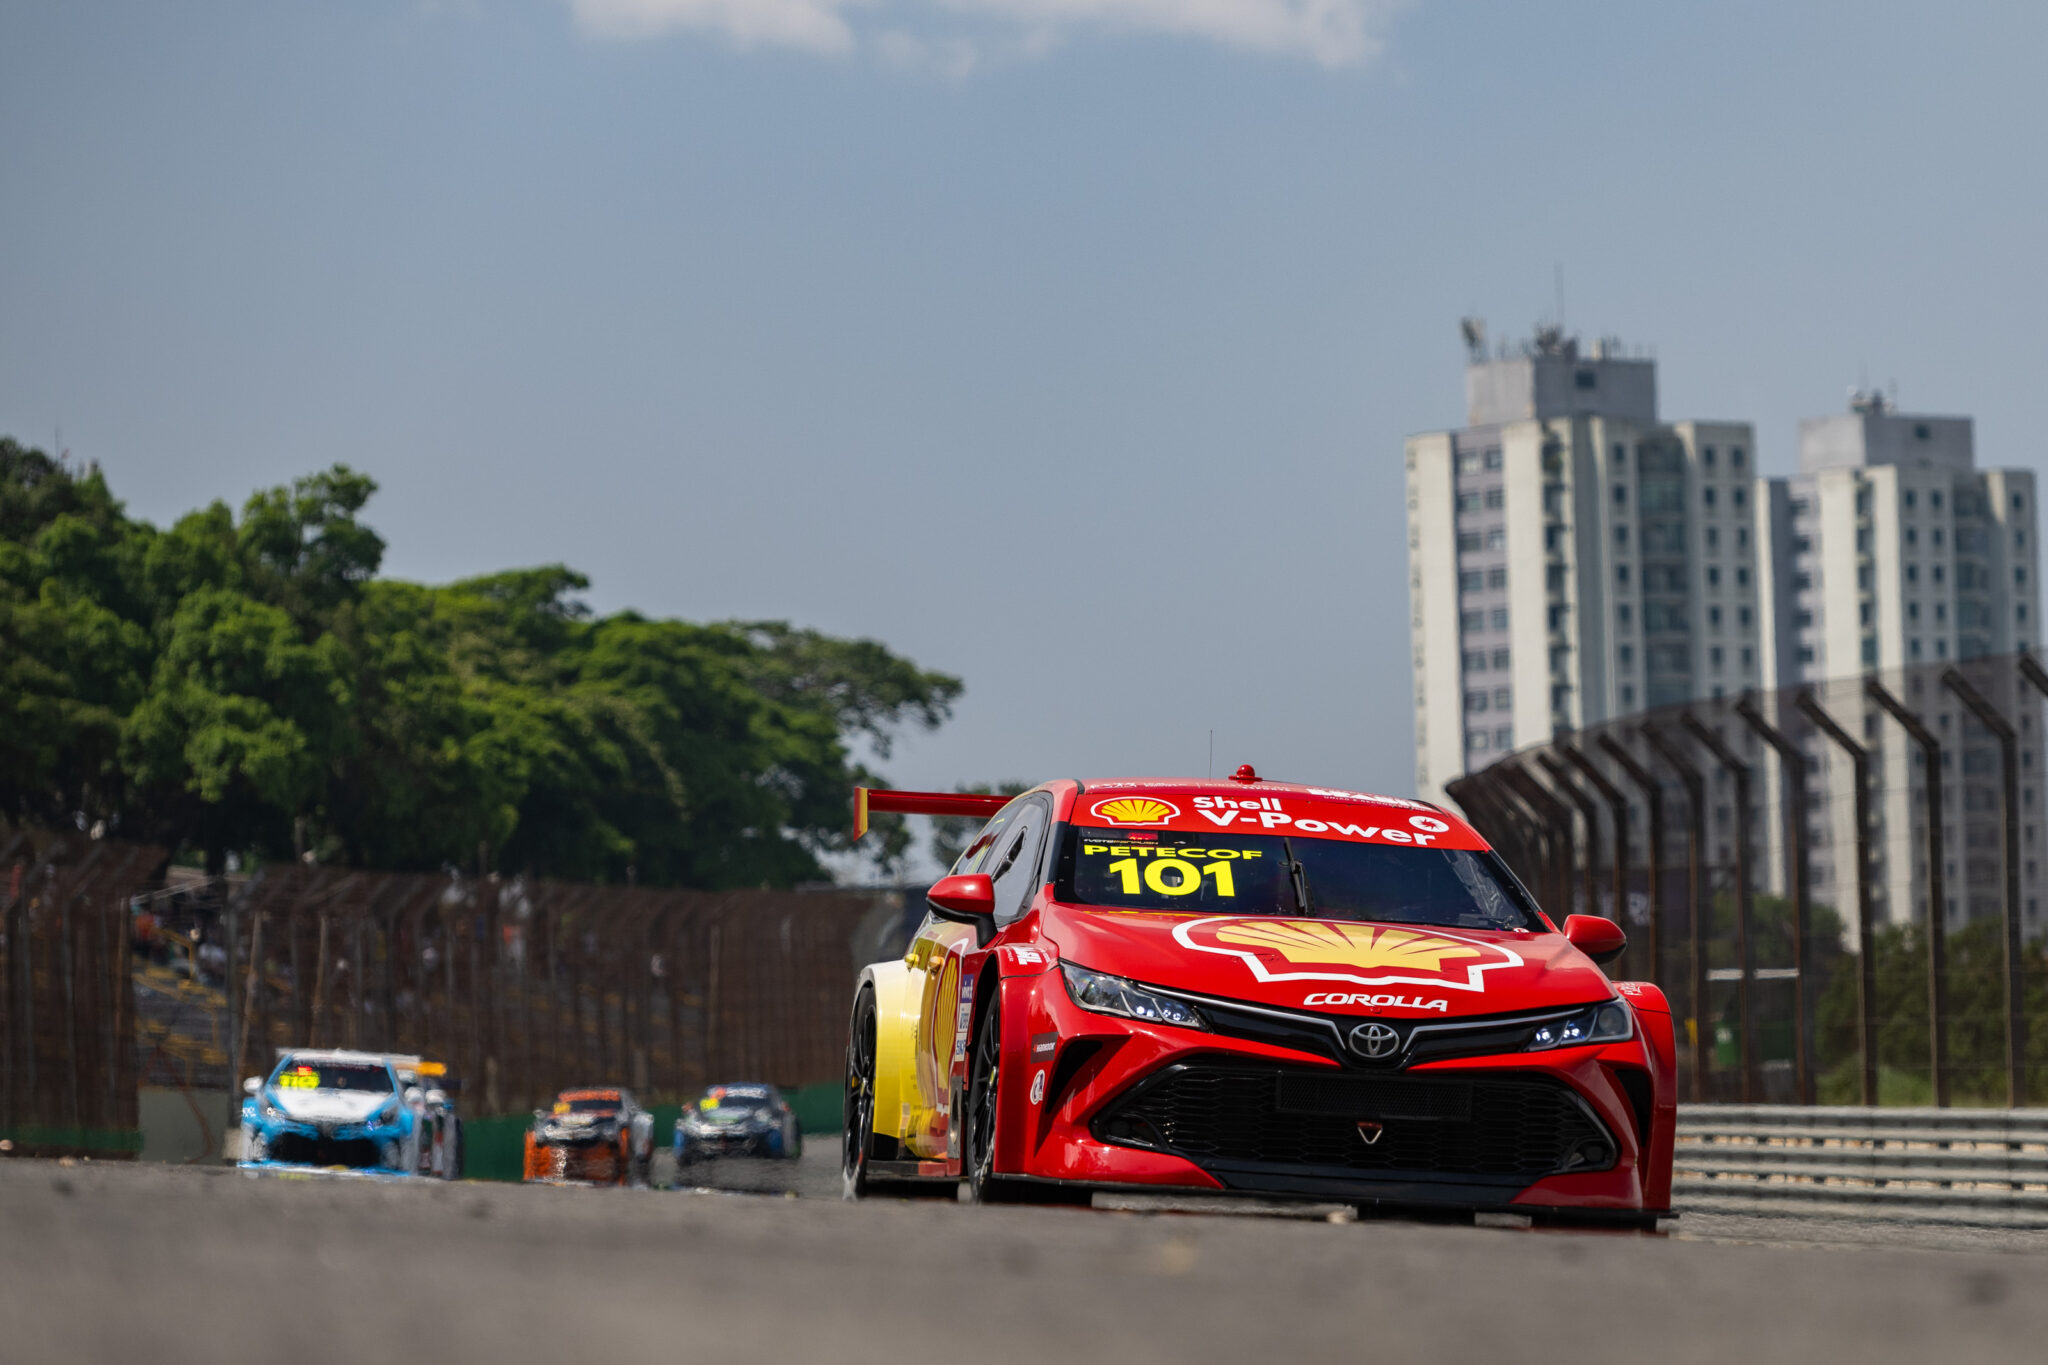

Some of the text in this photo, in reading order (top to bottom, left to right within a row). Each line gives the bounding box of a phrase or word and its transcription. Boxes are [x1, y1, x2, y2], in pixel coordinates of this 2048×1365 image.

[1192, 796, 1282, 812] Shell
[1199, 809, 1436, 846] V-Power
[1084, 845, 1263, 860] PETECOF
[1110, 858, 1236, 897] 101
[1303, 993, 1448, 1012] COROLLA
